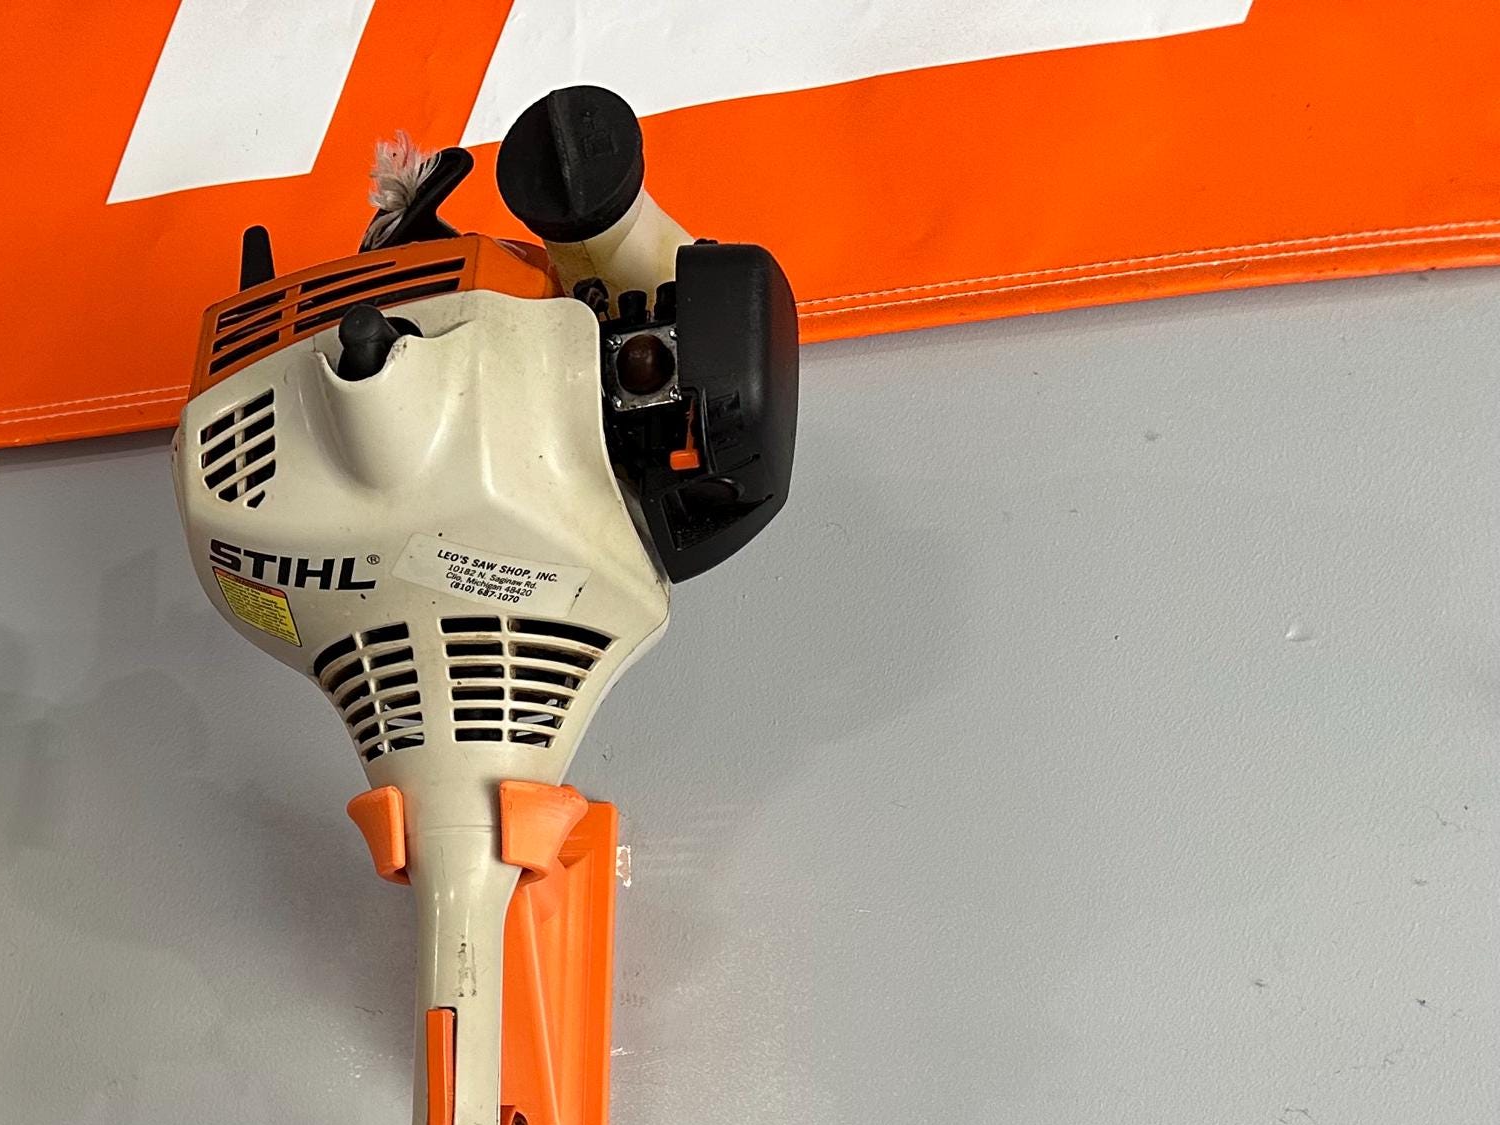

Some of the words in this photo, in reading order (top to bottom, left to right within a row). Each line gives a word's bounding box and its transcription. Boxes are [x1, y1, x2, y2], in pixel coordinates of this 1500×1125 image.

[437, 549, 469, 565] LEO'S
[471, 558, 498, 571] SAW
[499, 565, 532, 579] SHOP,
[535, 571, 558, 582] INC.
[448, 564, 476, 577] 10182
[477, 572, 487, 580] N.
[489, 574, 523, 588] Saginaw
[524, 582, 537, 590] Rd.
[449, 582, 475, 594] (810)
[477, 588, 520, 603] 687-1070
[466, 576, 502, 591] Michigan
[504, 585, 533, 597] 48420
